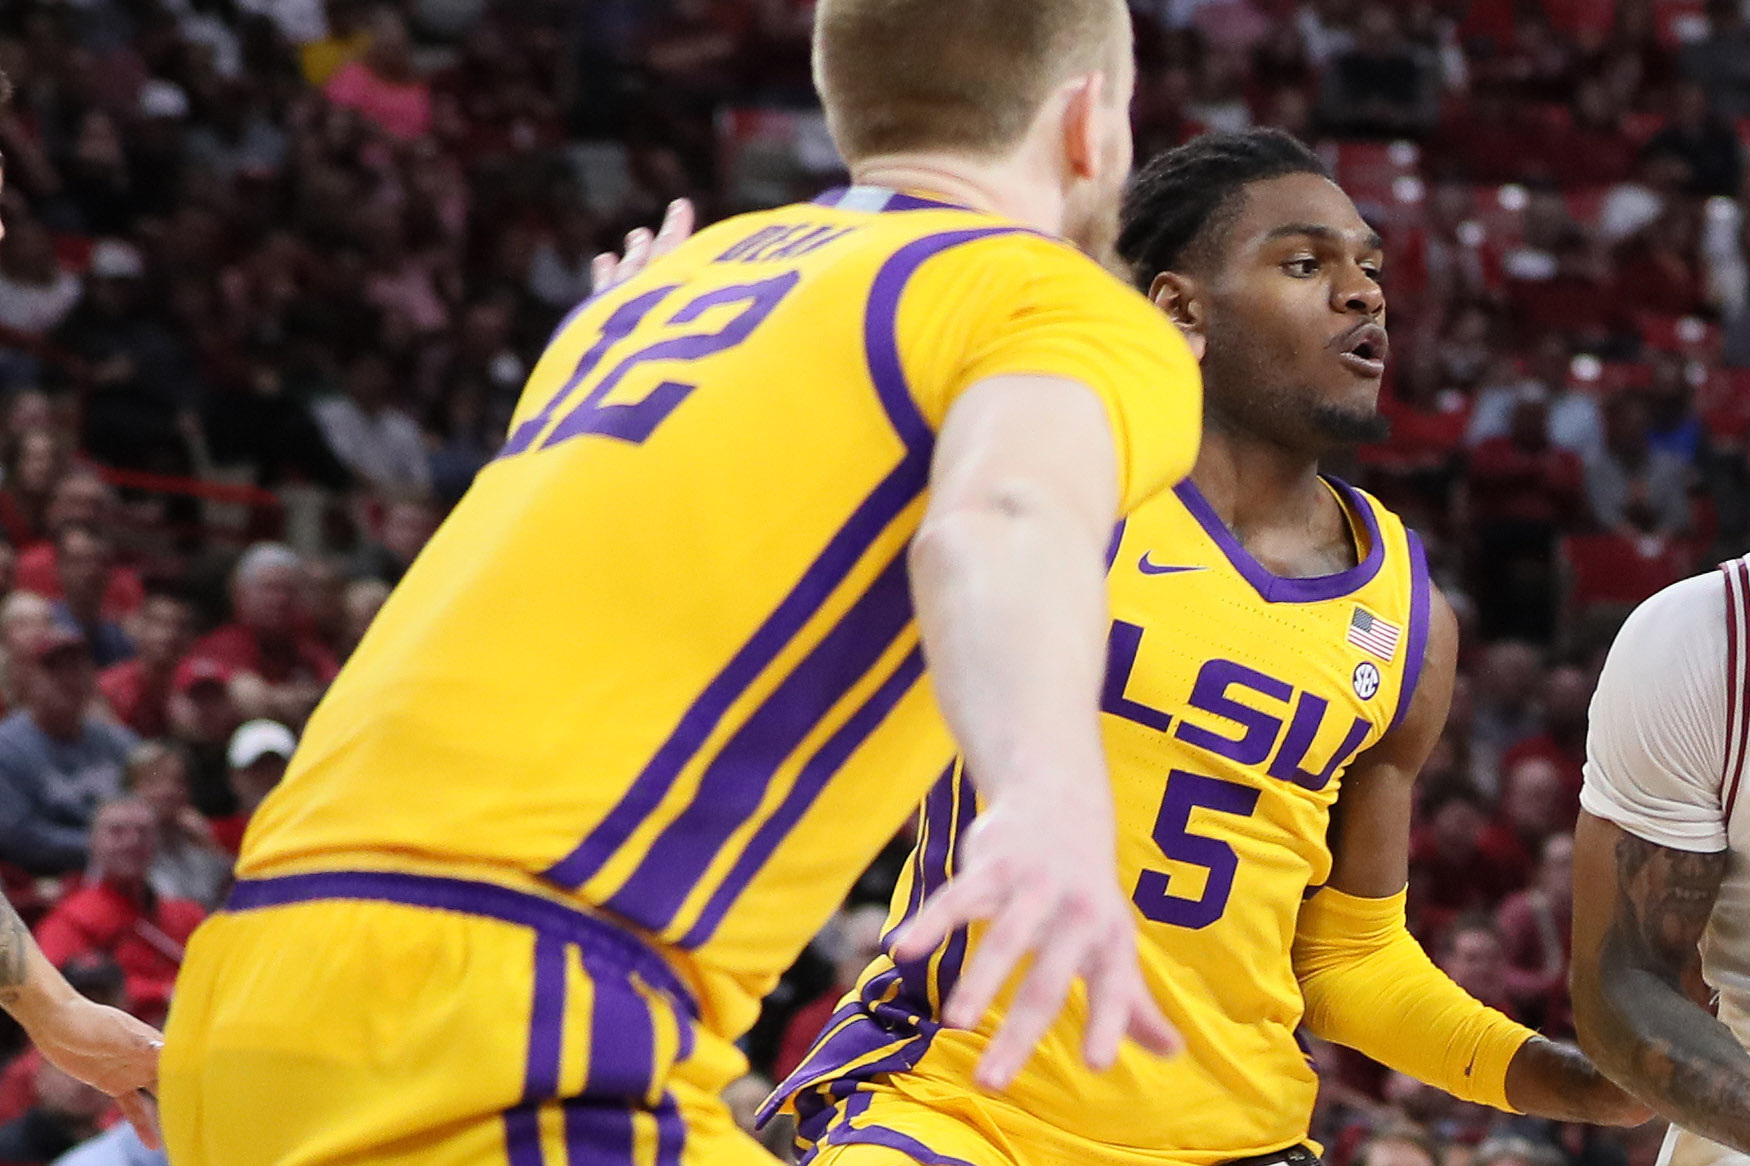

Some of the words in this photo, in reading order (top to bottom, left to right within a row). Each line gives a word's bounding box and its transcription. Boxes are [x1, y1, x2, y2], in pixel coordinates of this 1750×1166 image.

[500, 269, 800, 457] 12
[1098, 618, 1372, 791] LSU
[1354, 662, 1380, 699] SEC
[1132, 768, 1262, 930] 5
